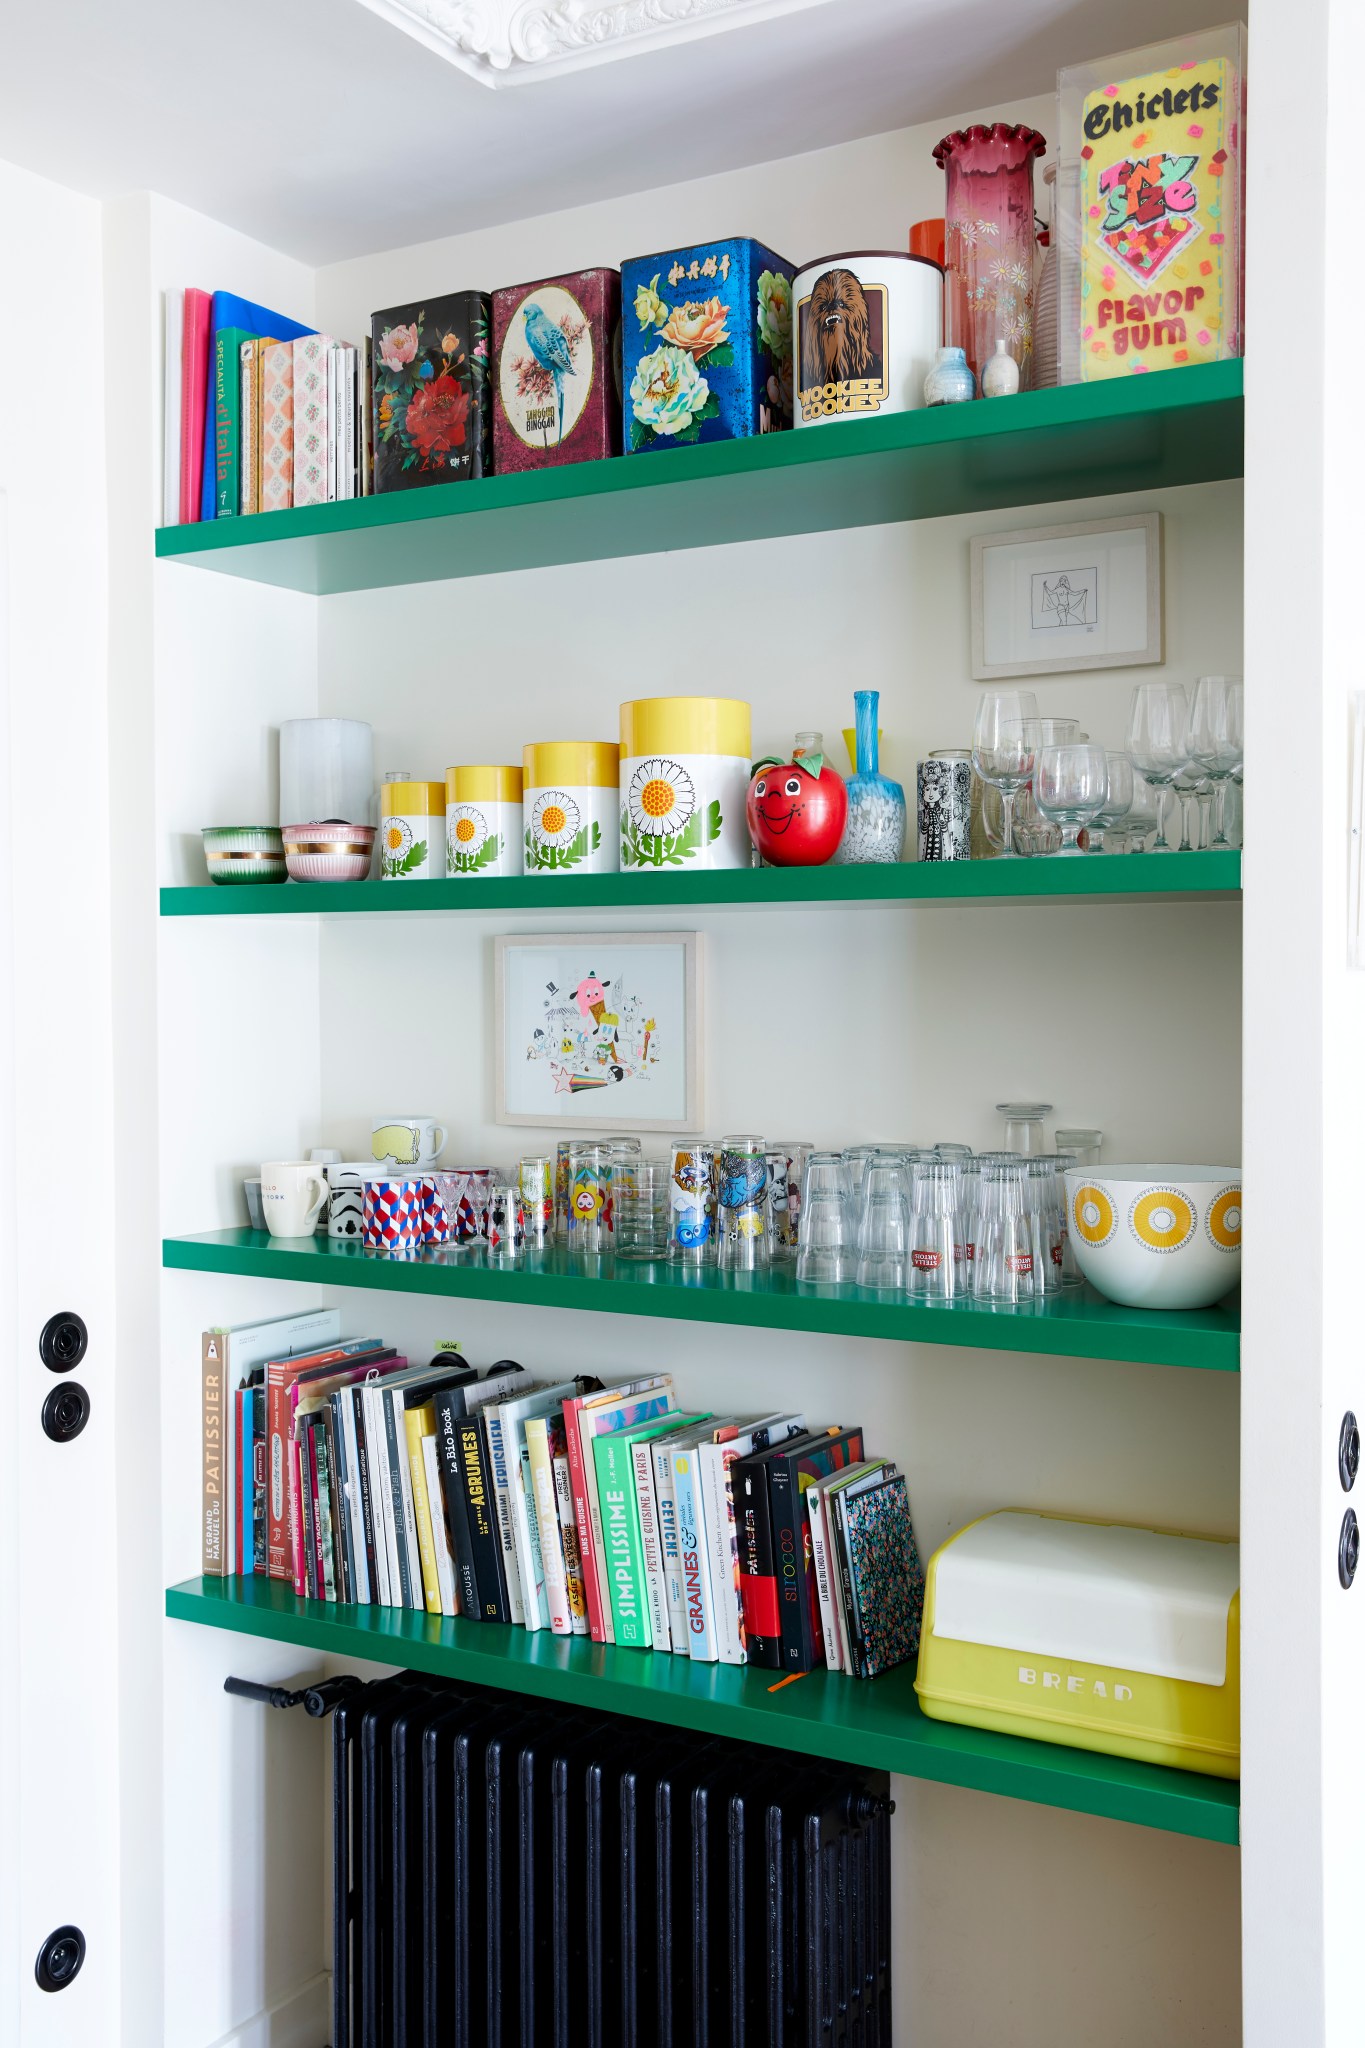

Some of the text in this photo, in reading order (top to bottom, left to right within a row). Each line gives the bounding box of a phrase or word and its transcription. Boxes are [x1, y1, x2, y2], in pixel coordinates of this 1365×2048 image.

[1084, 82, 1220, 140] Chiclets
[1098, 286, 1204, 328] flavor
[1113, 318, 1187, 356] gum
[217, 340, 225, 400] SPECIALITÀ
[800, 378, 882, 406] WOOKIEE
[802, 395, 880, 421] COOKIES
[217, 404, 232, 481] d'Italia
[526, 416, 554, 432] BINGGAN
[206, 1375, 219, 1494] PATISSIER
[442, 1408, 458, 1473] Le Bio Book
[412, 1456, 420, 1484] VIANDE
[462, 1432, 485, 1505] AGRUMES
[636, 1452, 648, 1481] PARIS
[213, 1501, 219, 1514] DU
[390, 1469, 403, 1534] Fish & Fish
[536, 1467, 552, 1516] vegan
[576, 1497, 585, 1524] CUISINE
[364, 1502, 372, 1544] mini-bouchées
[499, 1494, 512, 1551] SAMI TAMIMI
[525, 1493, 537, 1542] VEGETARIAN
[580, 1525, 586, 1535] MA
[640, 1496, 654, 1533] CUISINE
[661, 1500, 678, 1557] CEVICHE
[206, 1548, 212, 1558] LE
[540, 1521, 559, 1588] Healthy
[564, 1523, 580, 1606] ASSIETTES VEGGIE
[607, 1491, 636, 1617] SIMPLISSIME
[645, 1537, 658, 1572] PETITE
[715, 1531, 724, 1557] Kitchen
[817, 1555, 826, 1569] CHOU
[462, 1565, 474, 1613] LAROUSSE
[681, 1527, 704, 1633] GRAINES &
[820, 1579, 828, 1594] BIBLE
[1018, 1667, 1132, 1701] BREAD
